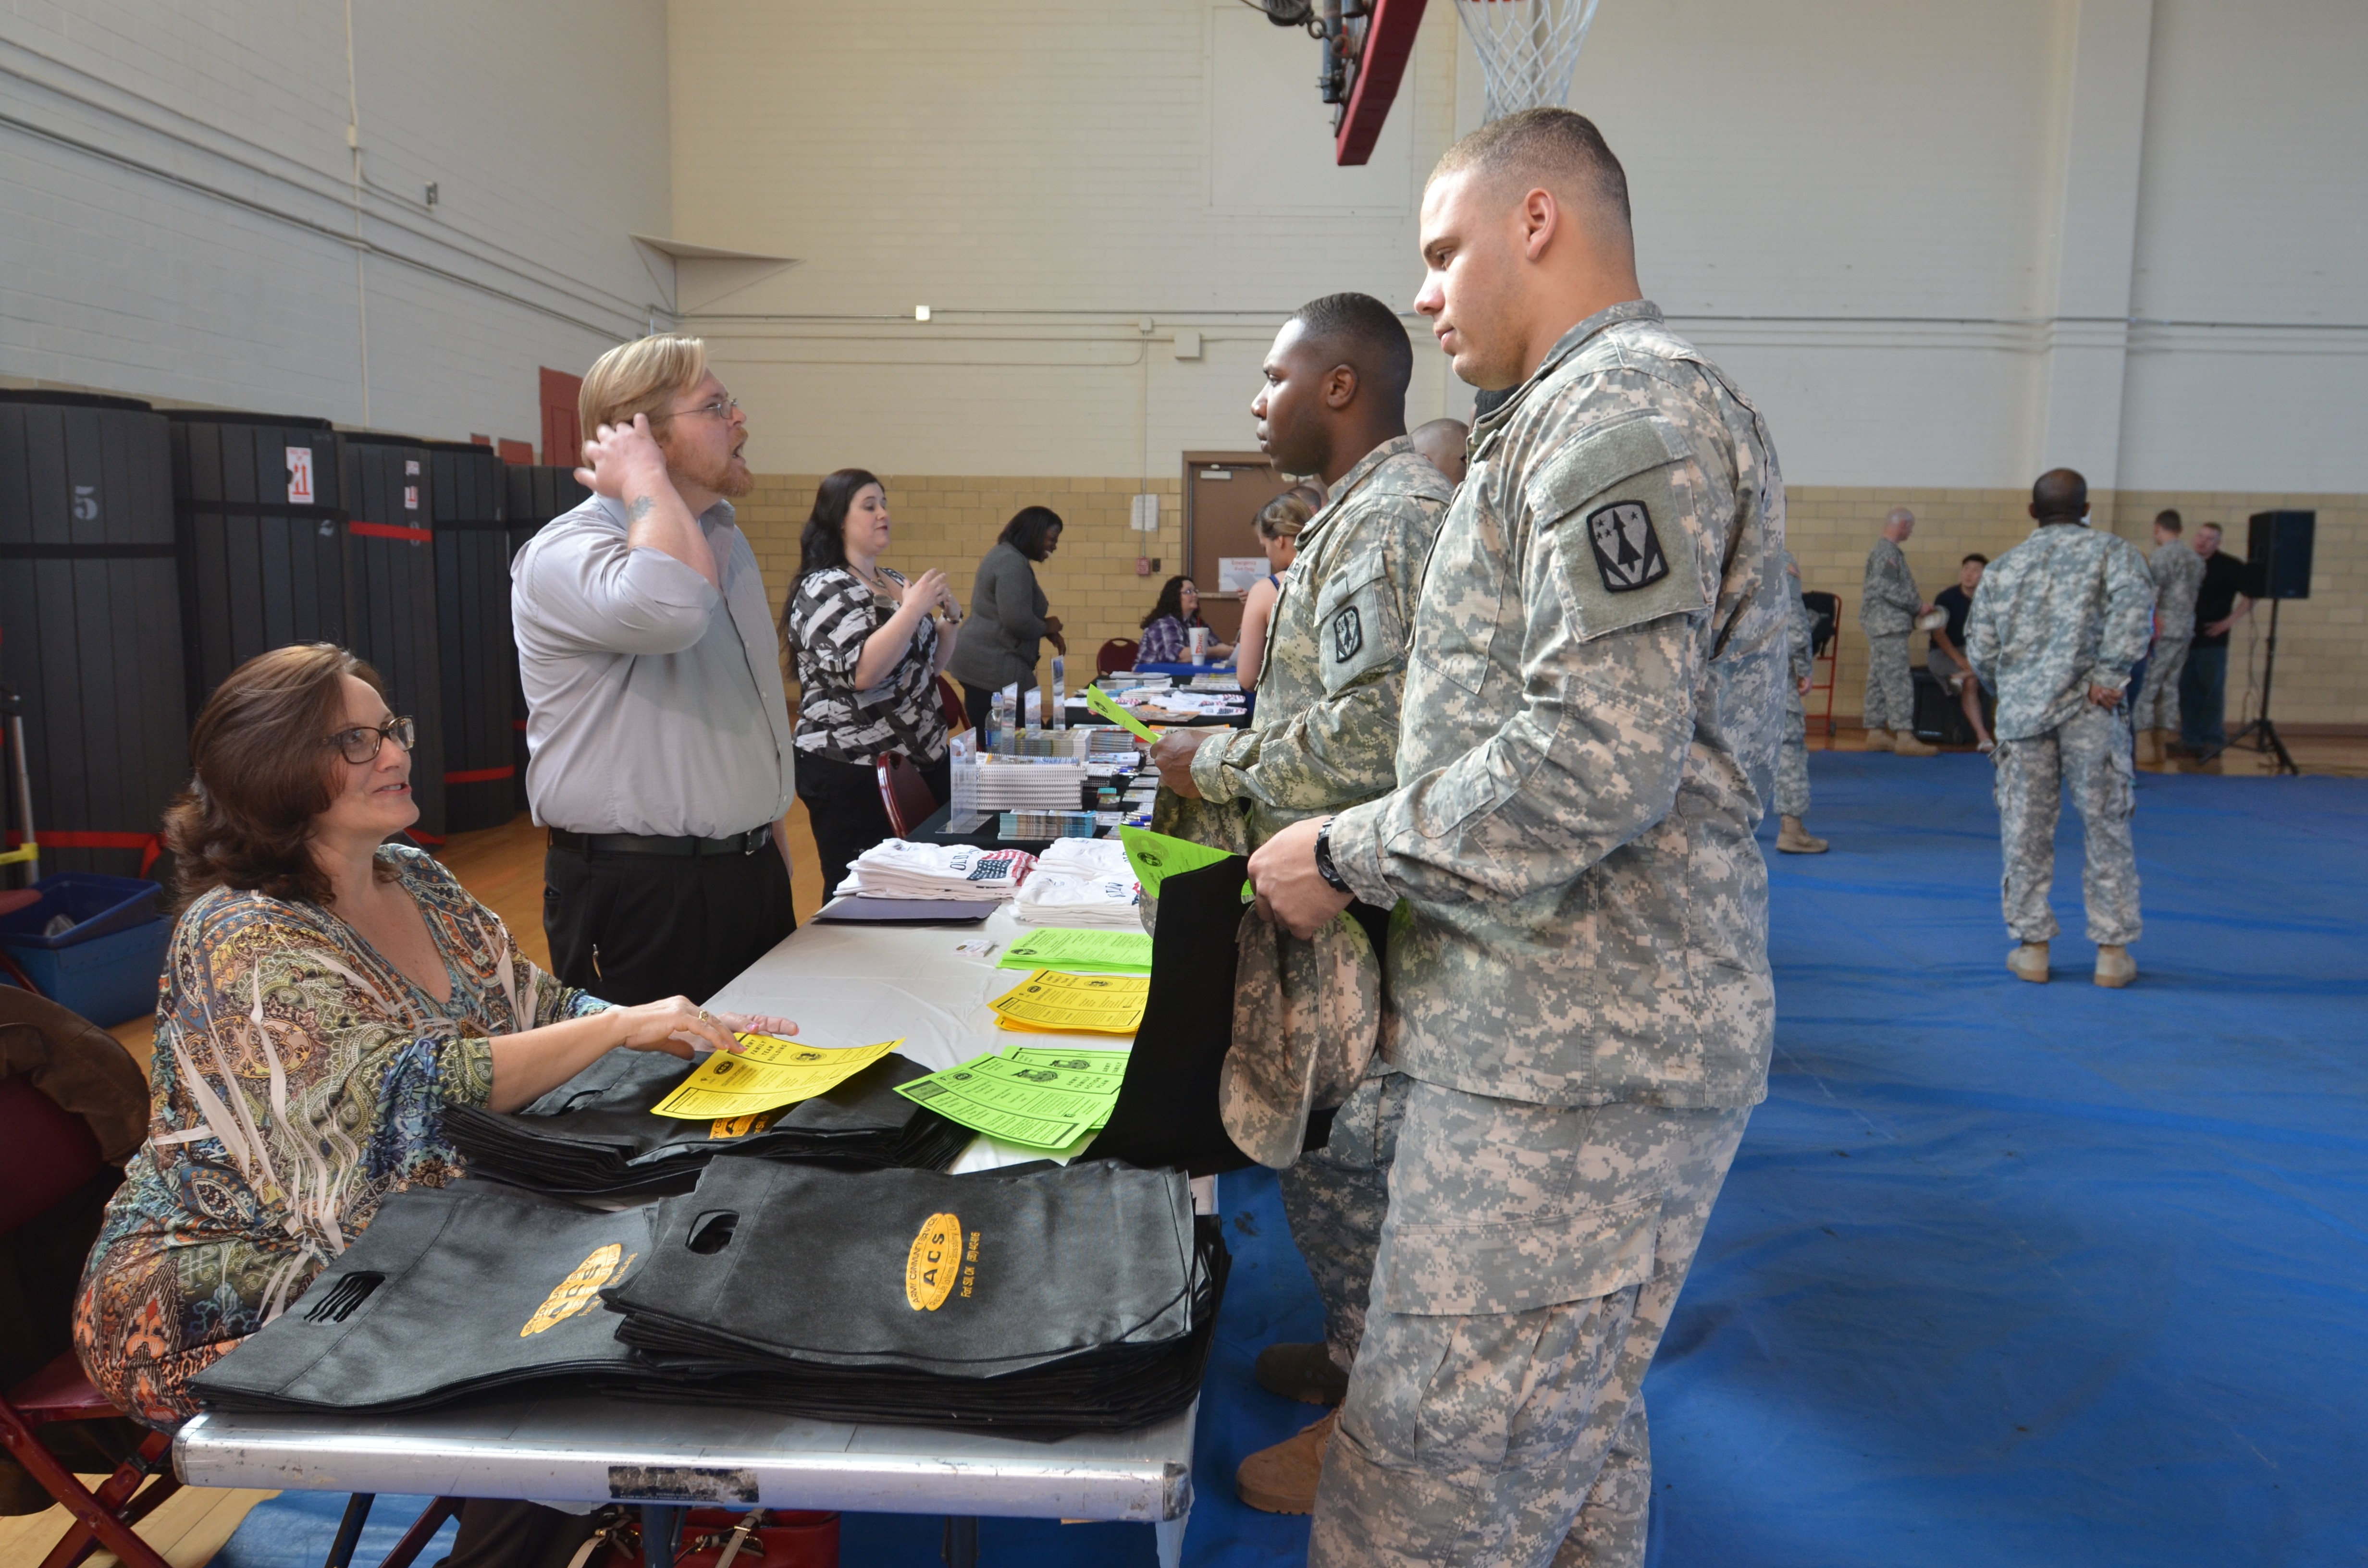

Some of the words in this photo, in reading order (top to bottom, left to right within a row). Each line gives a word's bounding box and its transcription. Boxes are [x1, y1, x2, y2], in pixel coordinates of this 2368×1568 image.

[74, 485, 98, 520] 5
[750, 1040, 766, 1055] FAMILY
[761, 1045, 774, 1056] TEAM
[767, 1044, 788, 1062] BUILDING
[923, 1233, 945, 1287] ACS
